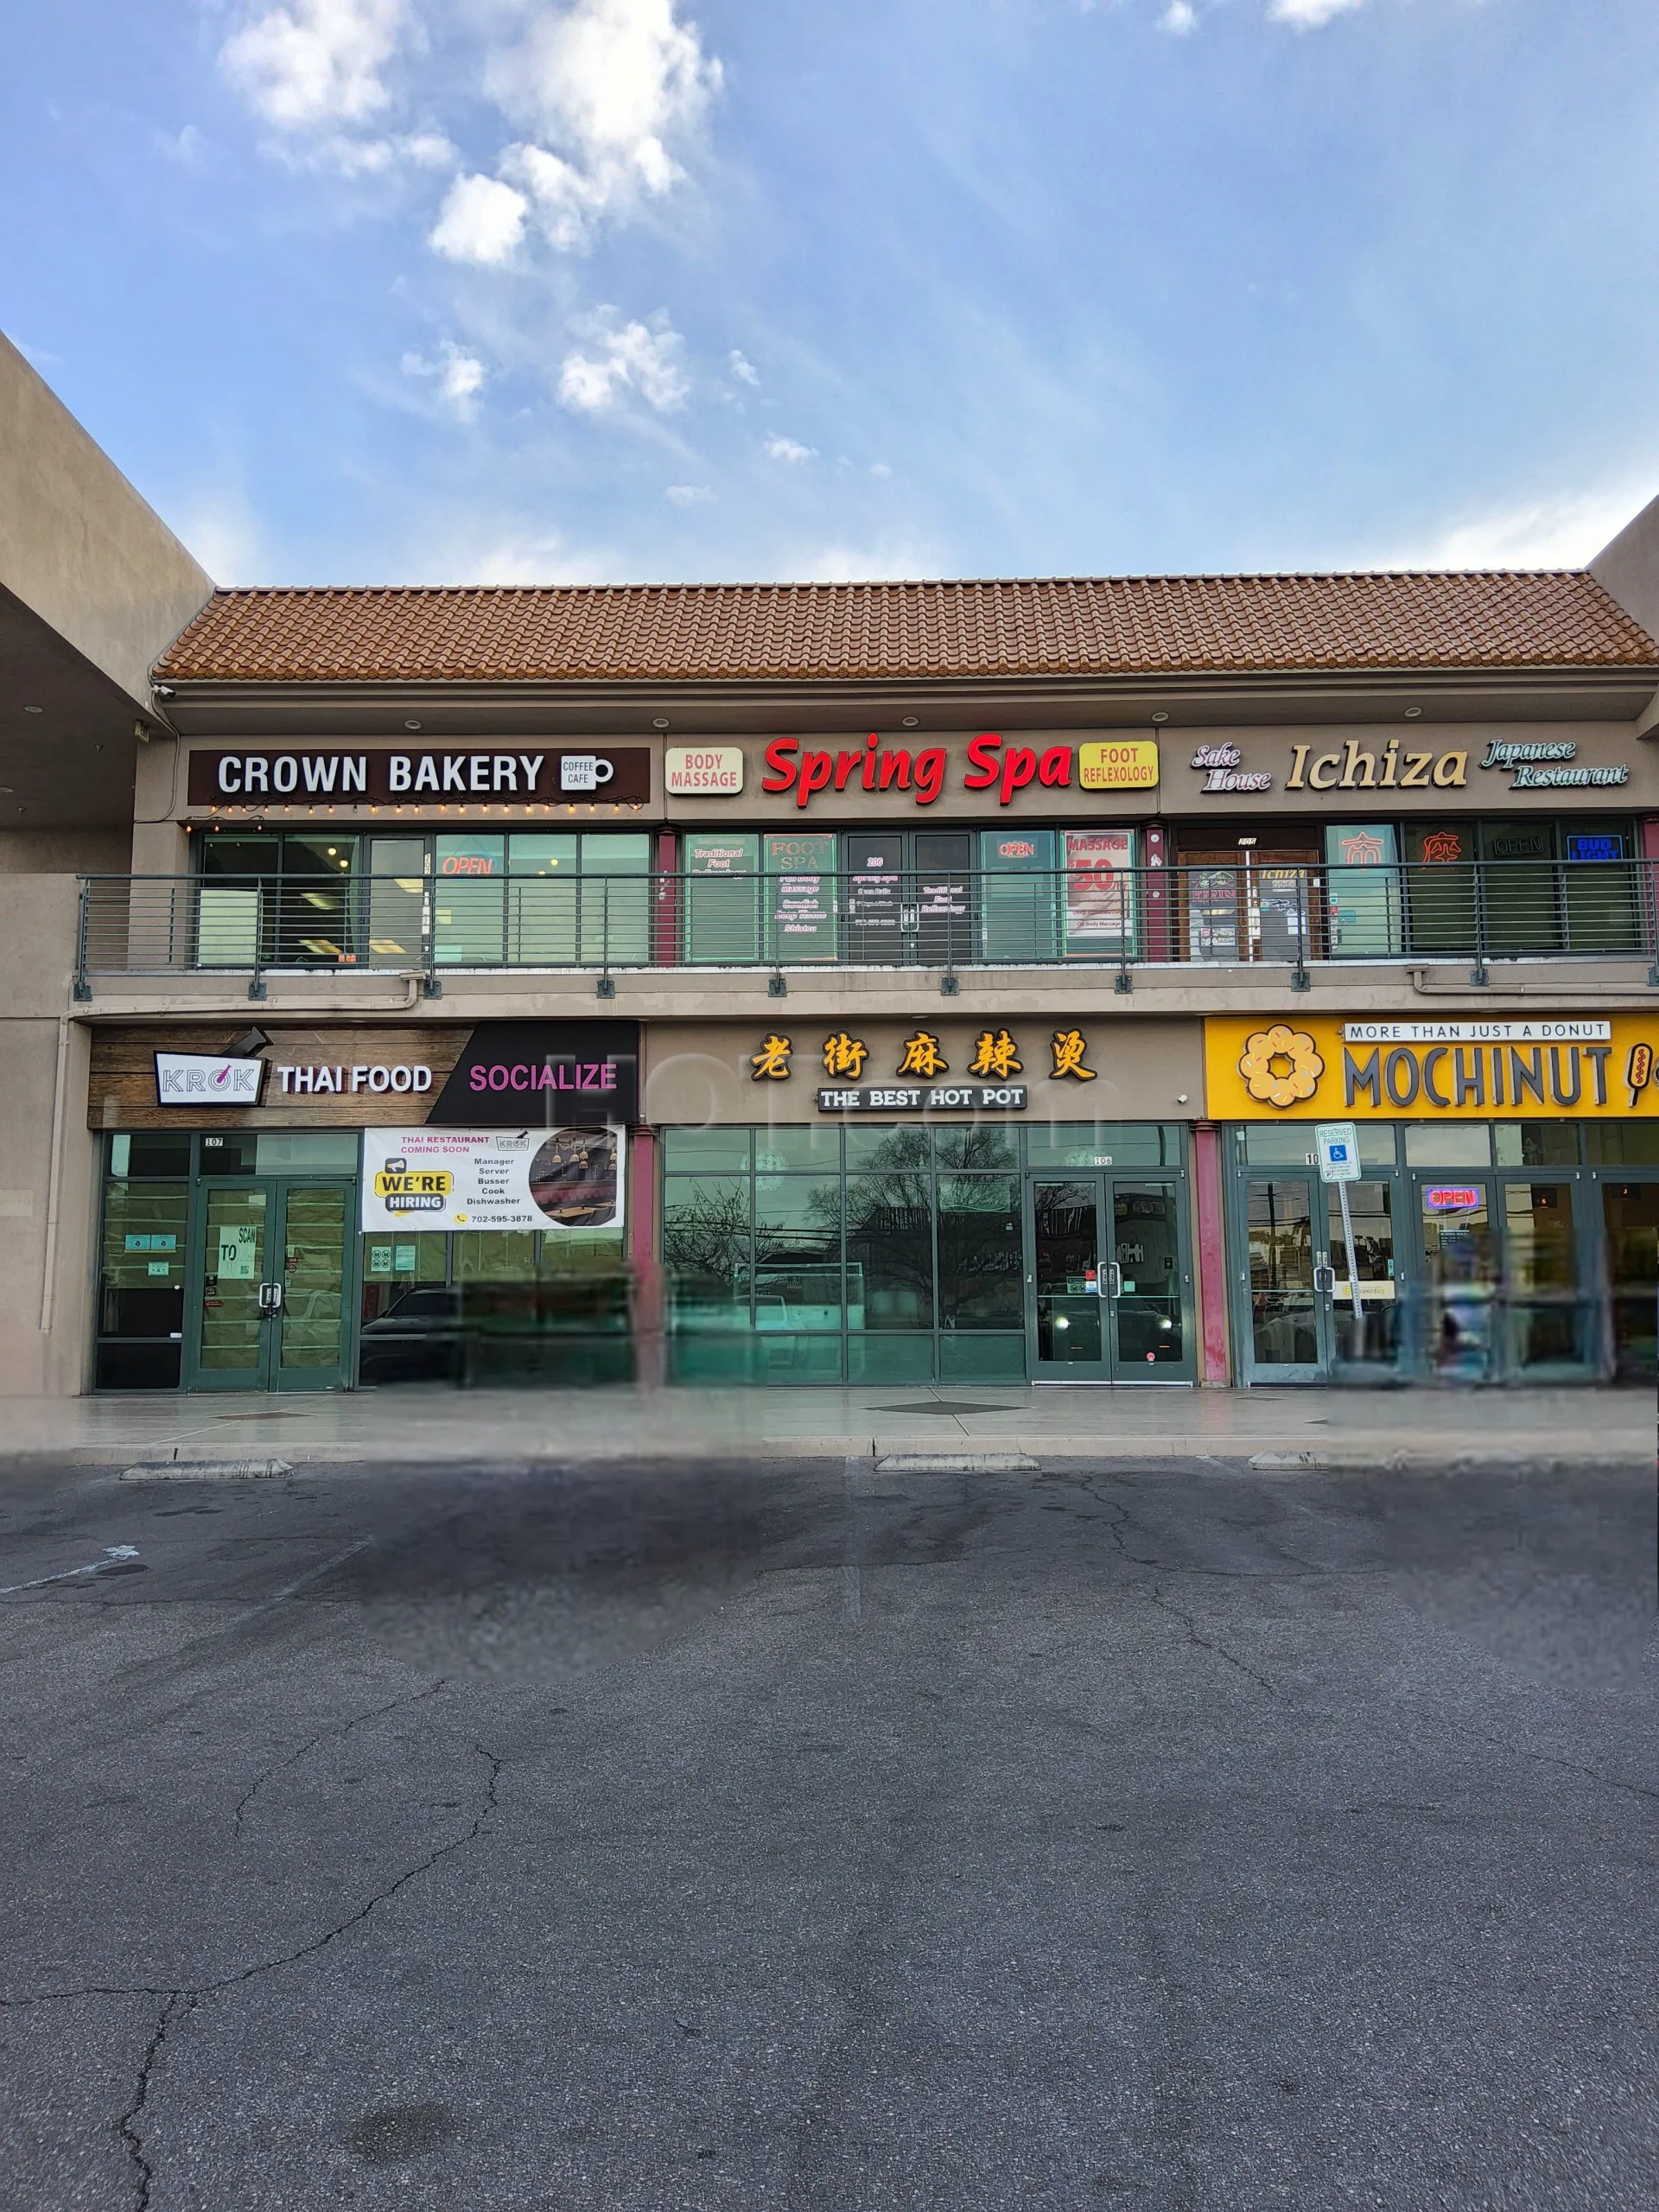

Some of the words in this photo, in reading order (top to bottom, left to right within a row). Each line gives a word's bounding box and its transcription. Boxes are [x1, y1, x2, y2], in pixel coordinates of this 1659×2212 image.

[684, 753, 723, 770] BODY
[1100, 747, 1138, 765] FOOT
[1191, 741, 1242, 768] Sake
[1480, 739, 1577, 768] Japanese
[219, 755, 368, 793] CROWN
[389, 754, 544, 791] BAKERY
[563, 761, 594, 772] COFFEE
[762, 732, 947, 809] Spring
[963, 733, 1073, 805] Spa
[1286, 739, 1469, 791] Ichiza
[568, 773, 588, 784] CAFE
[671, 771, 738, 788] MASSAGE
[1083, 764, 1154, 784] REFLEXOLOGY
[1204, 767, 1272, 793] House
[1511, 764, 1629, 791] Restaurant
[772, 841, 830, 856] FOOT
[999, 842, 1035, 857] OPEN
[1067, 837, 1128, 851] MASSAGE
[1496, 836, 1541, 855] OPEN
[1576, 838, 1613, 850] BUD
[694, 849, 744, 858] Traditional
[867, 856, 884, 867] 206
[442, 855, 495, 874] OPEN
[707, 858, 731, 868] Foot
[780, 855, 820, 870] SPA
[780, 883, 820, 895] Massage
[1350, 1025, 1401, 1039] MORE
[1410, 1024, 1461, 1038] THAN
[1469, 1023, 1512, 1037] JUST
[1522, 1023, 1534, 1037] A
[1541, 1022, 1605, 1036] DONUT
[162, 1066, 256, 1092] KROK
[277, 1065, 347, 1094] THAI
[353, 1065, 433, 1093] FOOD
[469, 1063, 618, 1092] SOCIALIZE
[1342, 1046, 1612, 1108] MOCHINUT
[820, 1090, 861, 1107] THE
[869, 1090, 921, 1106] BEST
[930, 1089, 973, 1106] HOT
[982, 1088, 1025, 1105] POT
[1319, 1128, 1352, 1138] RESERVED
[1323, 1135, 1351, 1145] PARKING
[474, 1158, 515, 1166] Manager
[382, 1175, 447, 1192] WE'RE
[389, 1196, 442, 1210] HIRING
[467, 1197, 521, 1205] Dishwasher
[1430, 1190, 1477, 1205] OPEN
[471, 1214, 533, 1224] 702-595-3878
[238, 1227, 256, 1243] SCAN
[221, 1244, 237, 1261] TO
